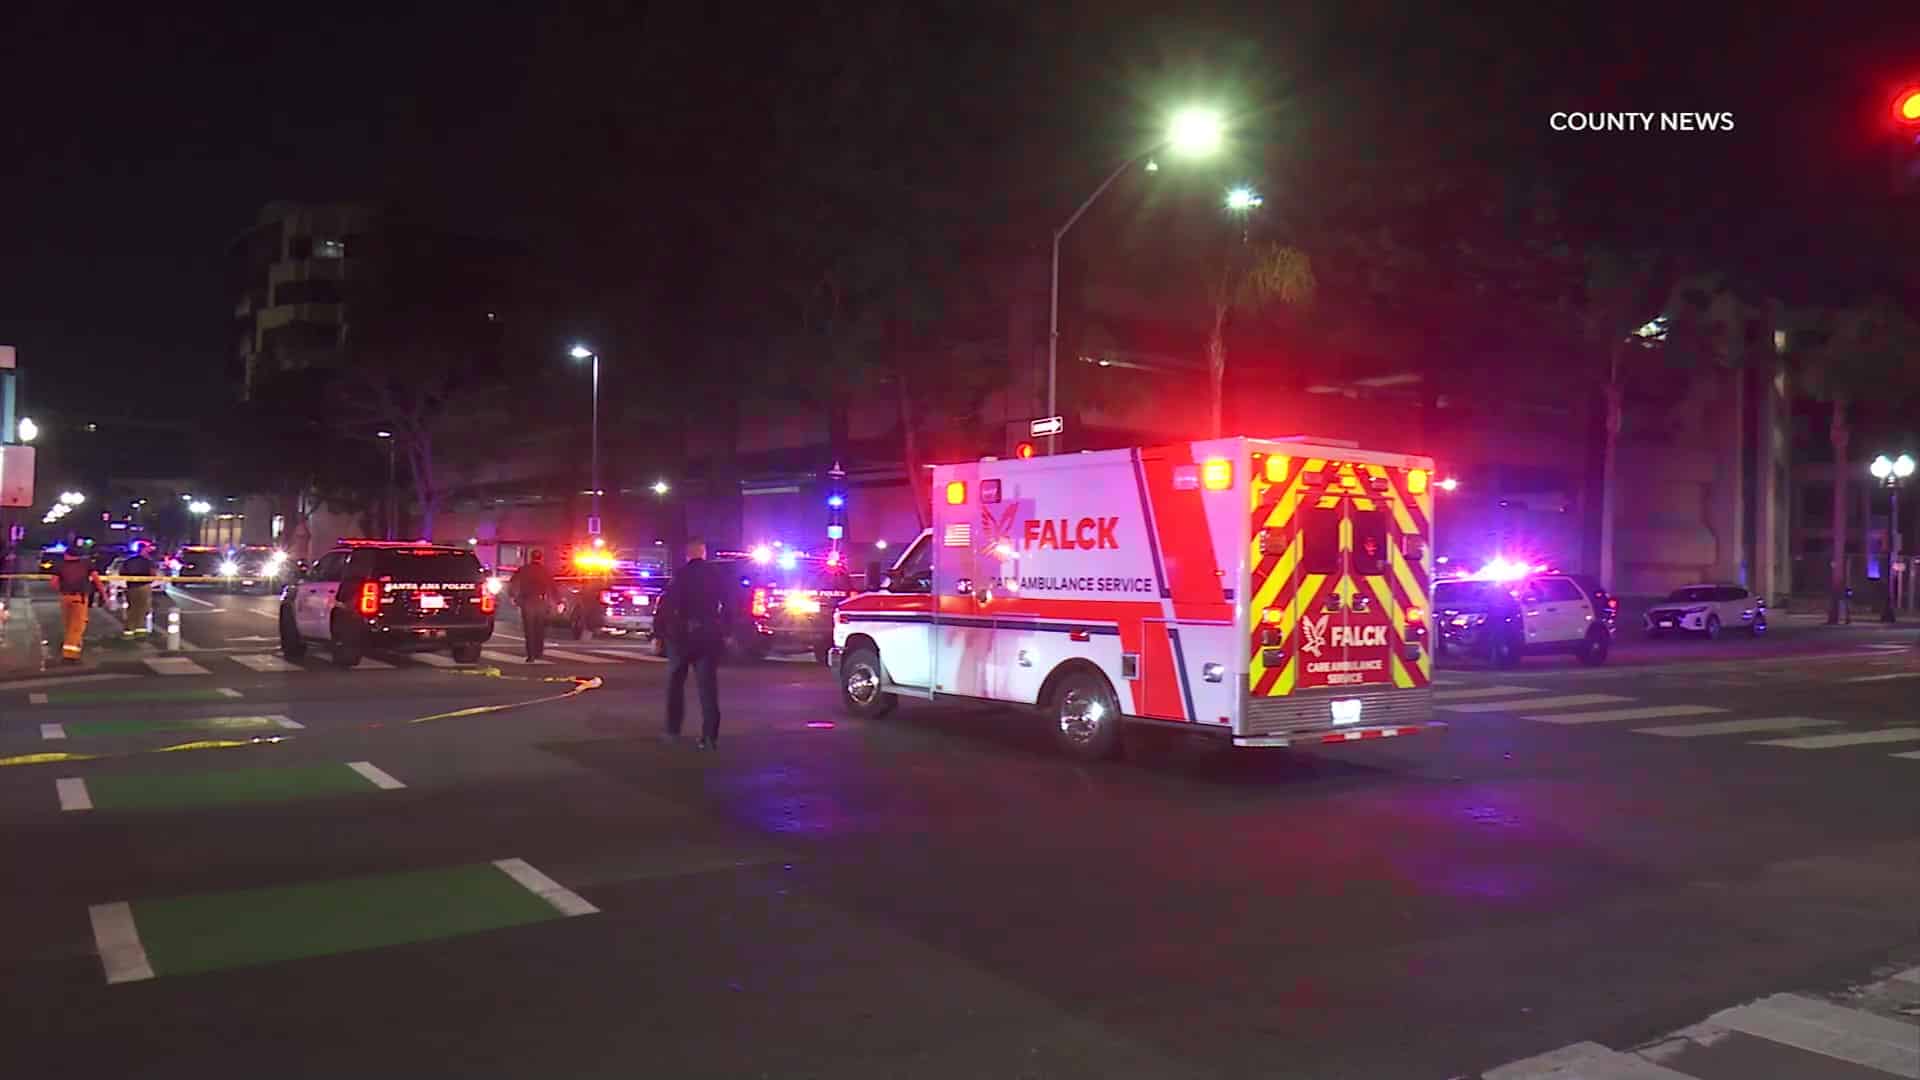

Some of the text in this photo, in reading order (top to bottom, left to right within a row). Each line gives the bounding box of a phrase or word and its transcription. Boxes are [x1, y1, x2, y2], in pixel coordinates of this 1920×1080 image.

[1024, 517, 1120, 550] FALCK
[442, 582, 476, 591] POLICE
[1021, 576, 1094, 592] AMBULANCE
[1097, 577, 1152, 593] SERVICE
[1331, 625, 1388, 647] FALCK
